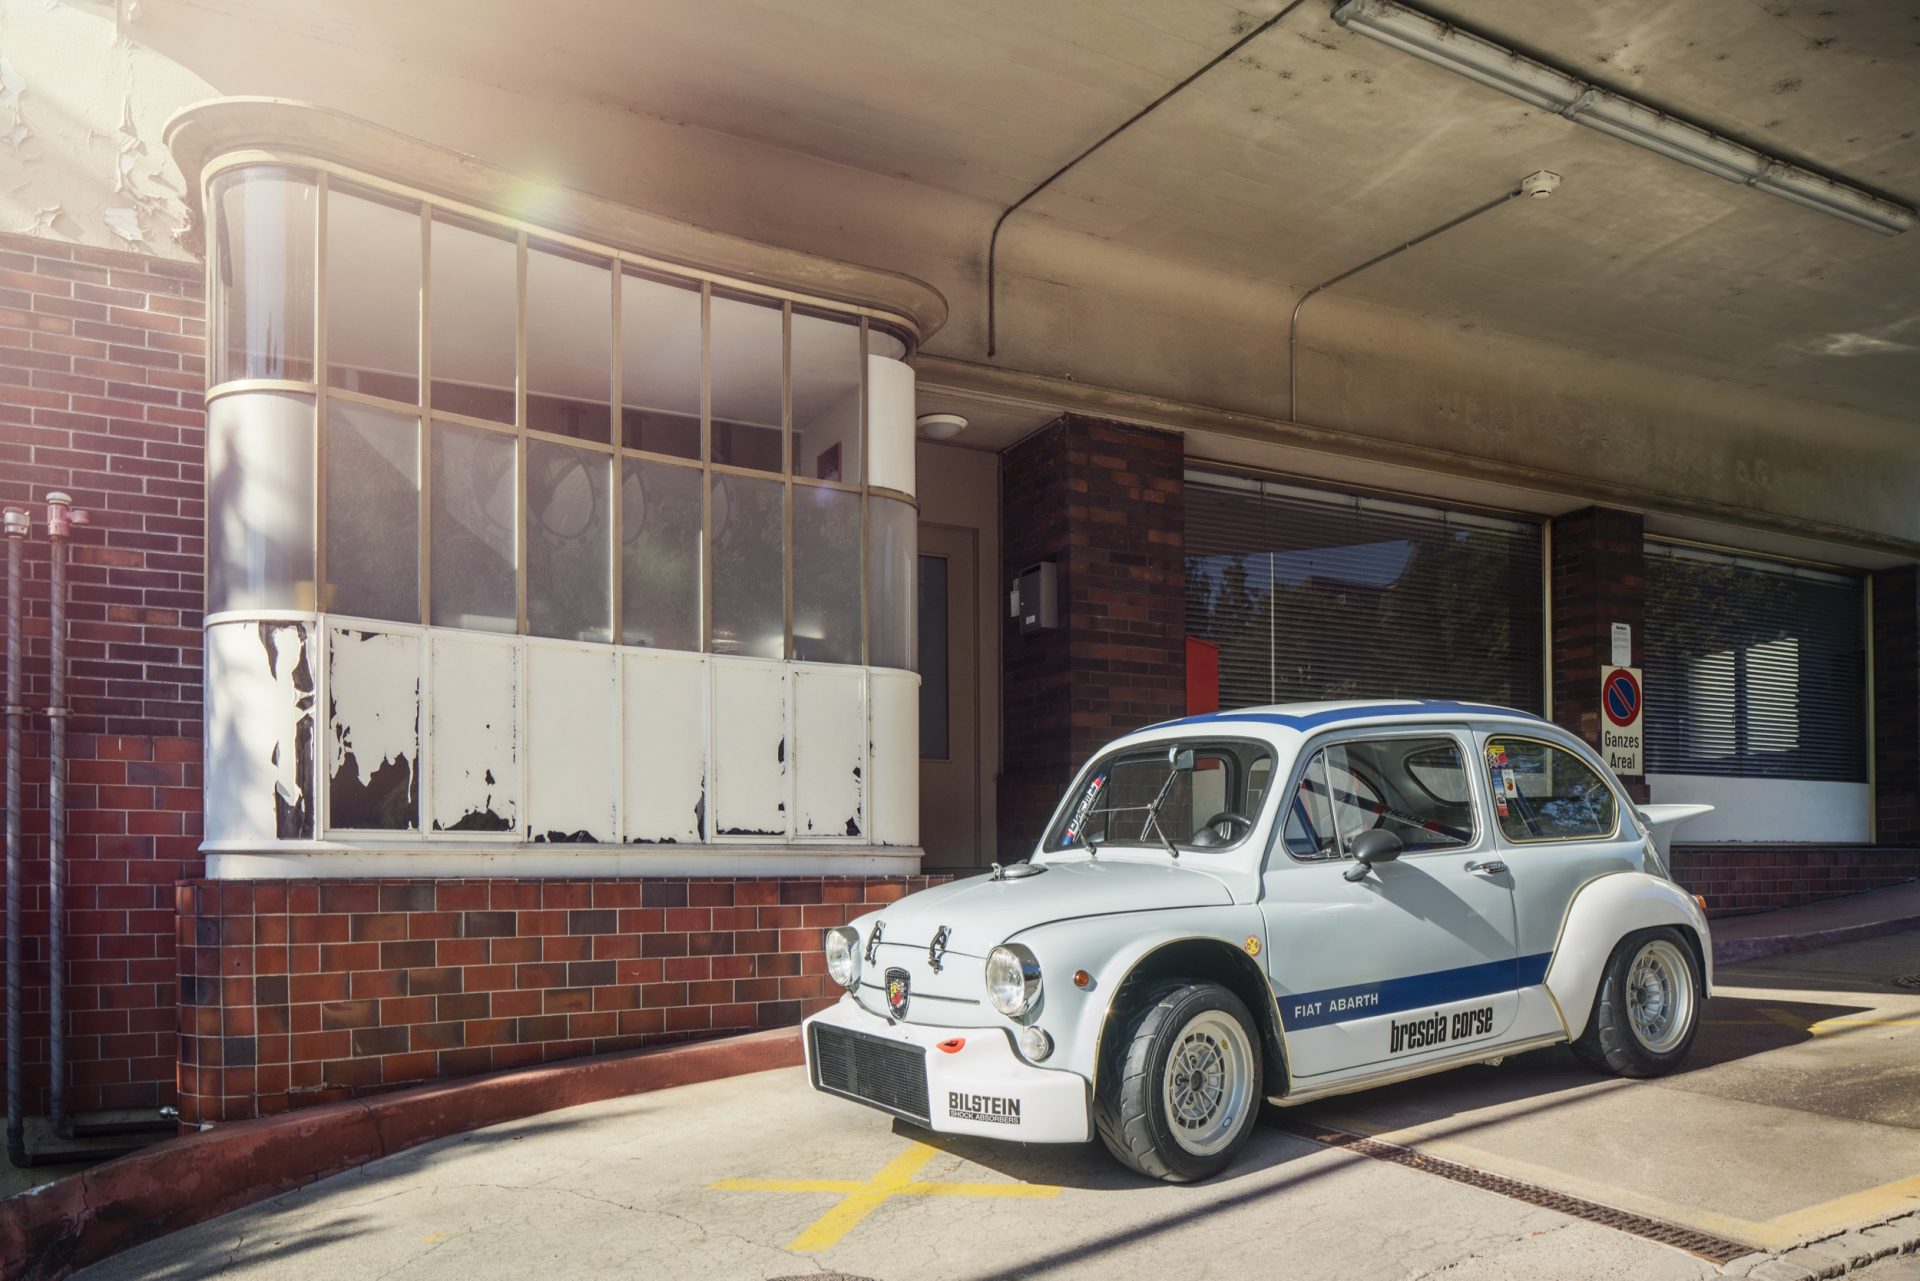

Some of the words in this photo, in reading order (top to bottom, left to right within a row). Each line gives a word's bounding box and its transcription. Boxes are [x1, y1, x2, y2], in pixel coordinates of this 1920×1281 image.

[1604, 730, 1640, 749] Ganzes
[1610, 752, 1636, 769] Areal
[1294, 1002, 1322, 1019] FIAT
[1329, 993, 1379, 1013] ABARTH
[1390, 1011, 1447, 1053] brescia
[1451, 1006, 1493, 1041] corse
[948, 1091, 1021, 1116] BILSTEIN
[950, 1109, 974, 1120] SHOCK
[975, 1113, 1019, 1124] ABSORBERS
